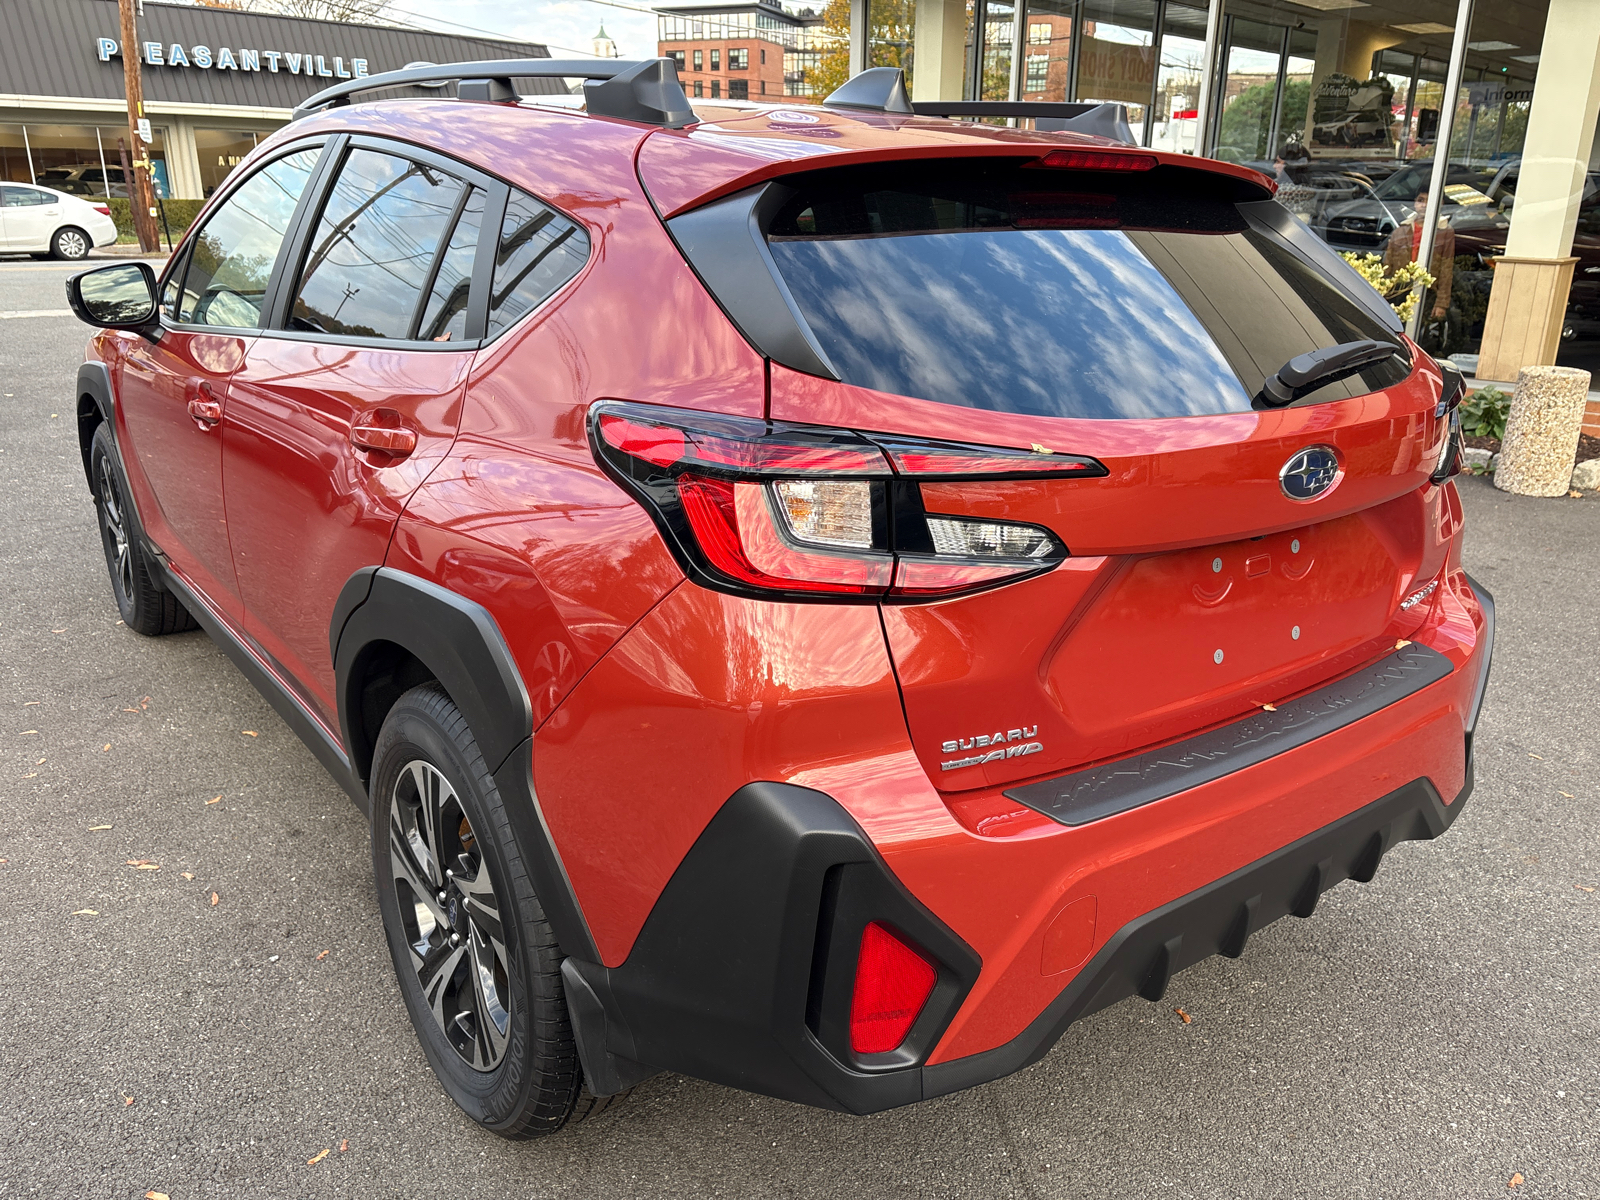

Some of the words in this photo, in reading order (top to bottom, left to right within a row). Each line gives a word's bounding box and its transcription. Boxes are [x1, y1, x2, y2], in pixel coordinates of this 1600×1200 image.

[96, 37, 369, 79] PEASANTVILLE
[1314, 84, 1358, 98] Adventure
[941, 724, 1038, 754] SUBARU
[981, 742, 1044, 764] AWD
[490, 1027, 525, 1117] YOKOHAMA
